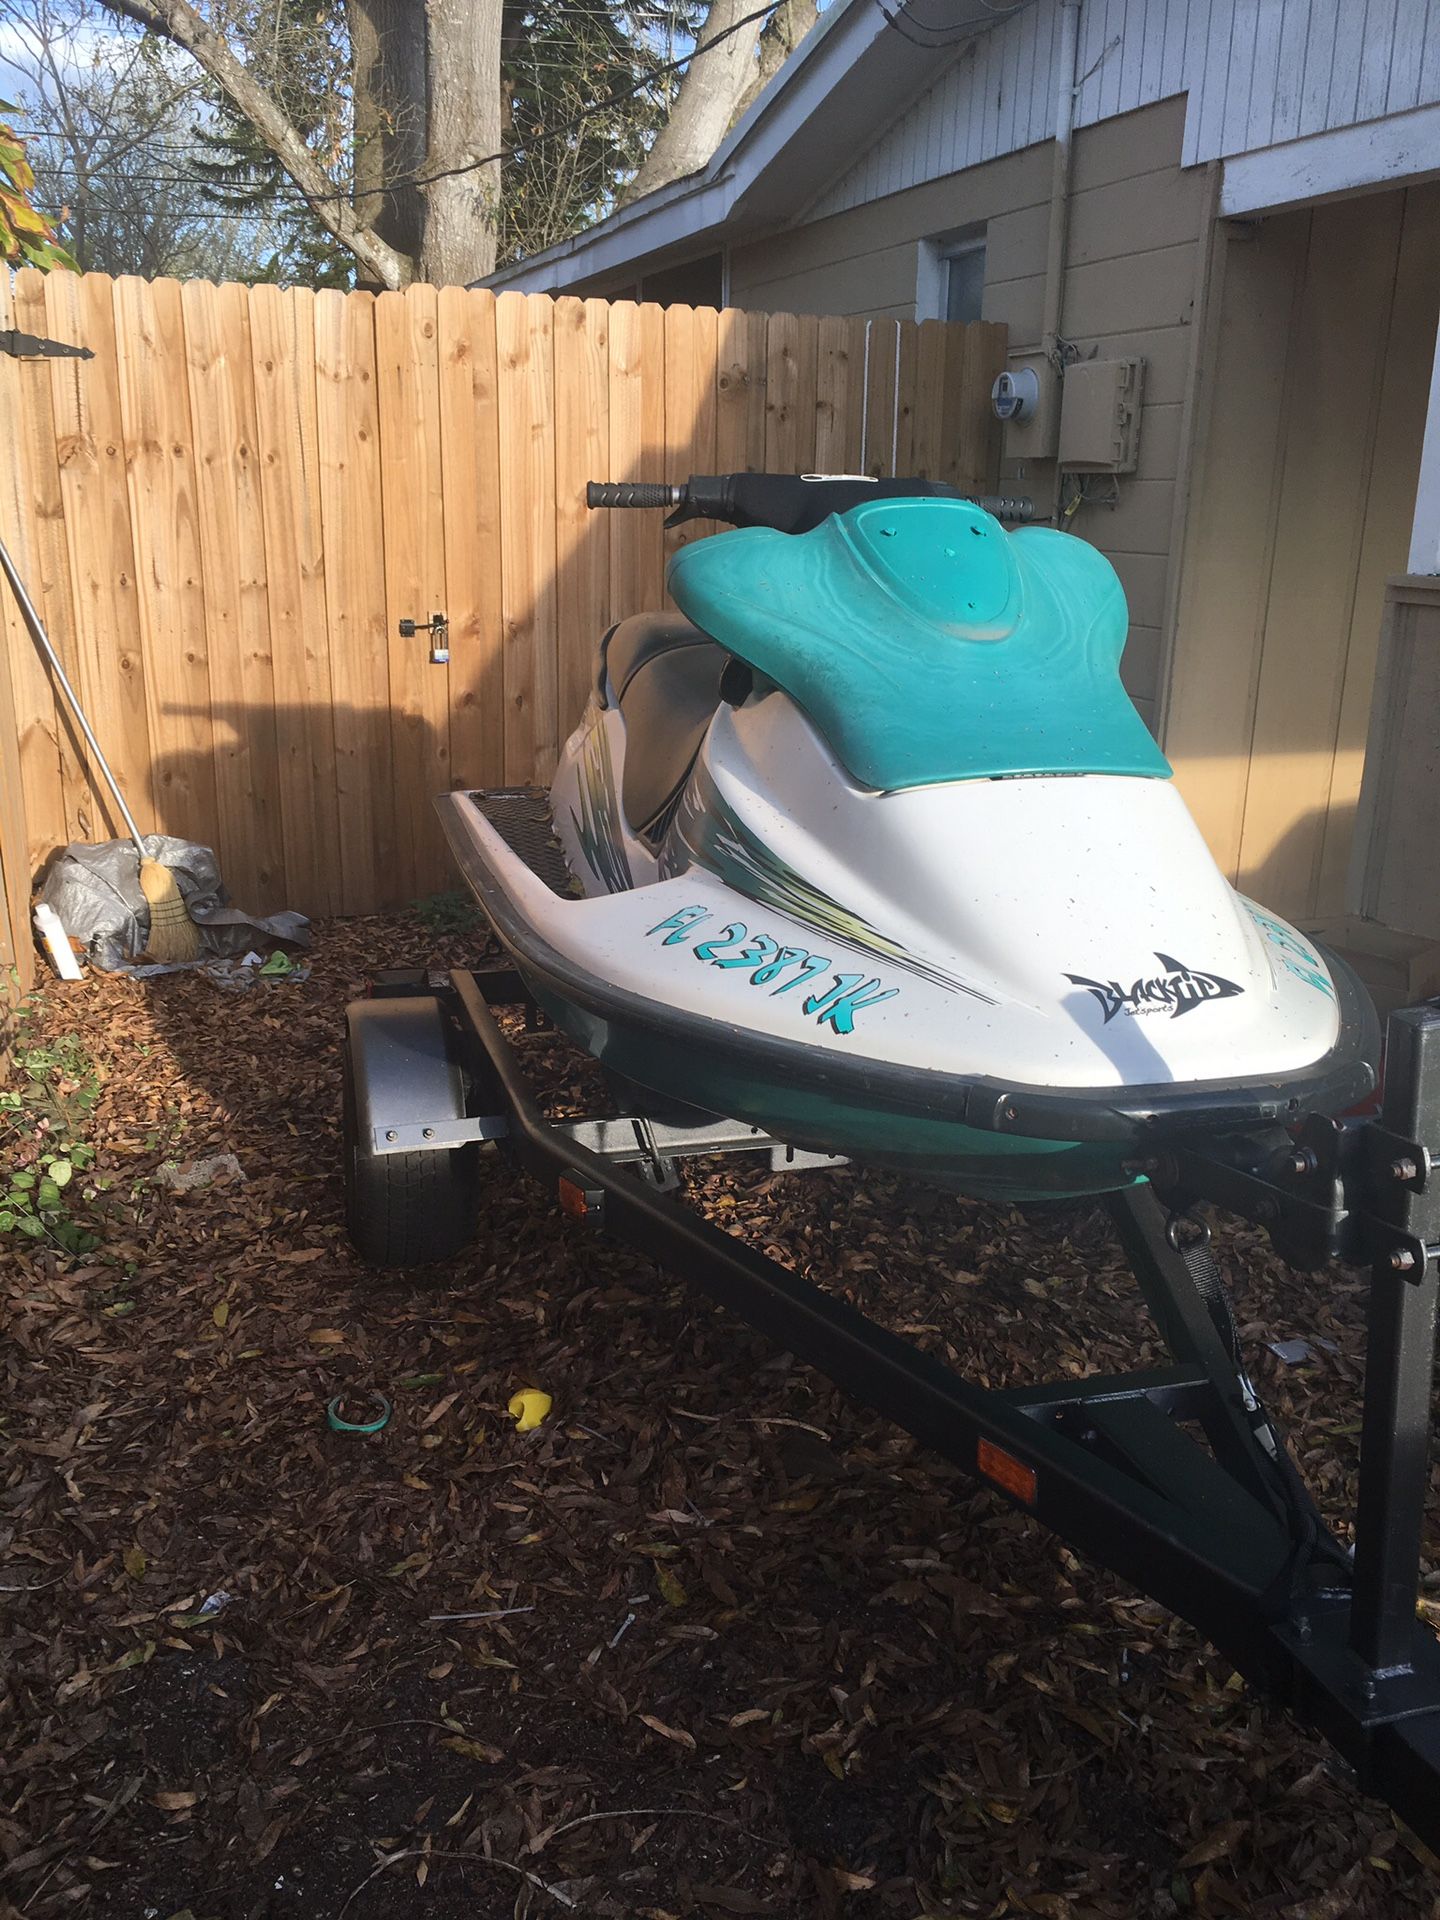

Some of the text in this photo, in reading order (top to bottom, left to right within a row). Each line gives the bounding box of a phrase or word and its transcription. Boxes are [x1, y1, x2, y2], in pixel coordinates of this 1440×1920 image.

[645, 905, 900, 1035] FL 2387 JK
